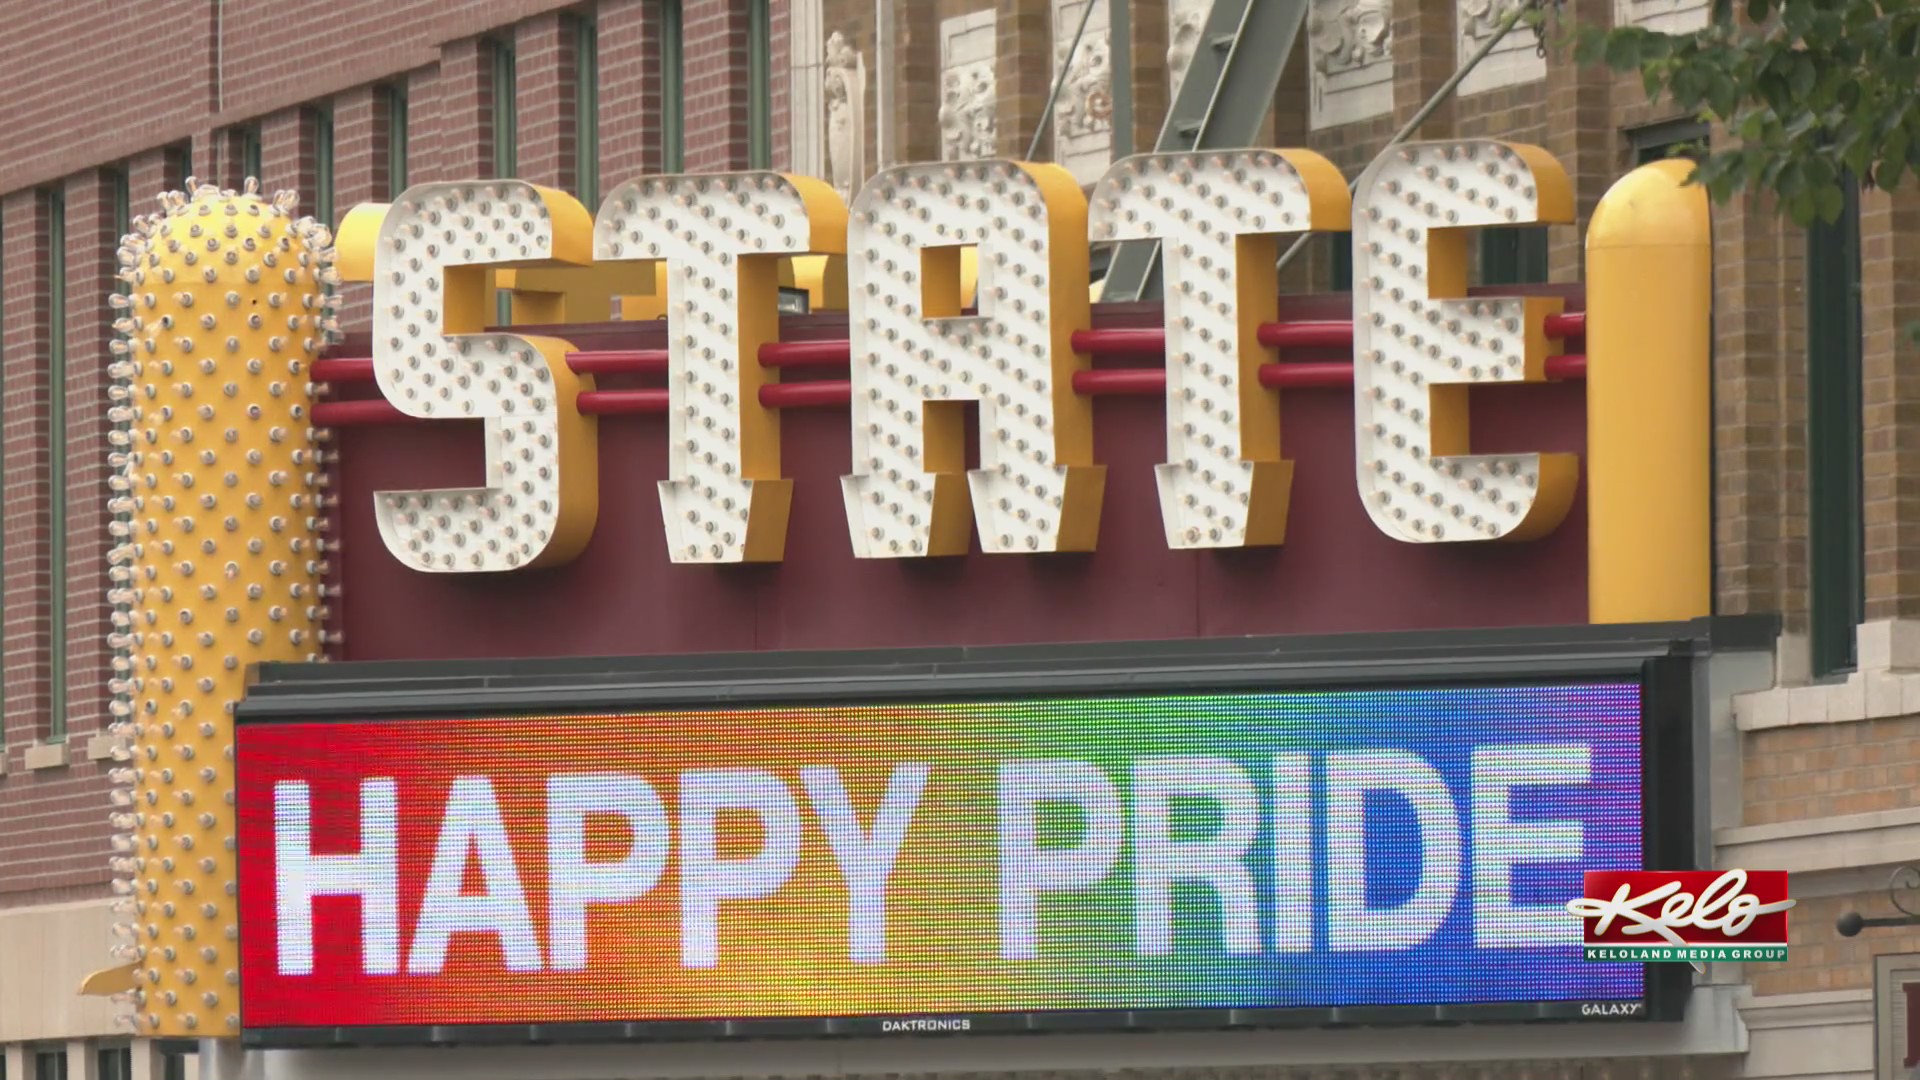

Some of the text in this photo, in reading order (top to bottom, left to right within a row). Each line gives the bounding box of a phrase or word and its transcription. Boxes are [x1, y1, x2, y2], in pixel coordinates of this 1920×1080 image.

[372, 138, 1578, 574] STATE
[274, 742, 1592, 976] HAPPY PRIDE
[882, 1019, 971, 1032] DAKTRONICS
